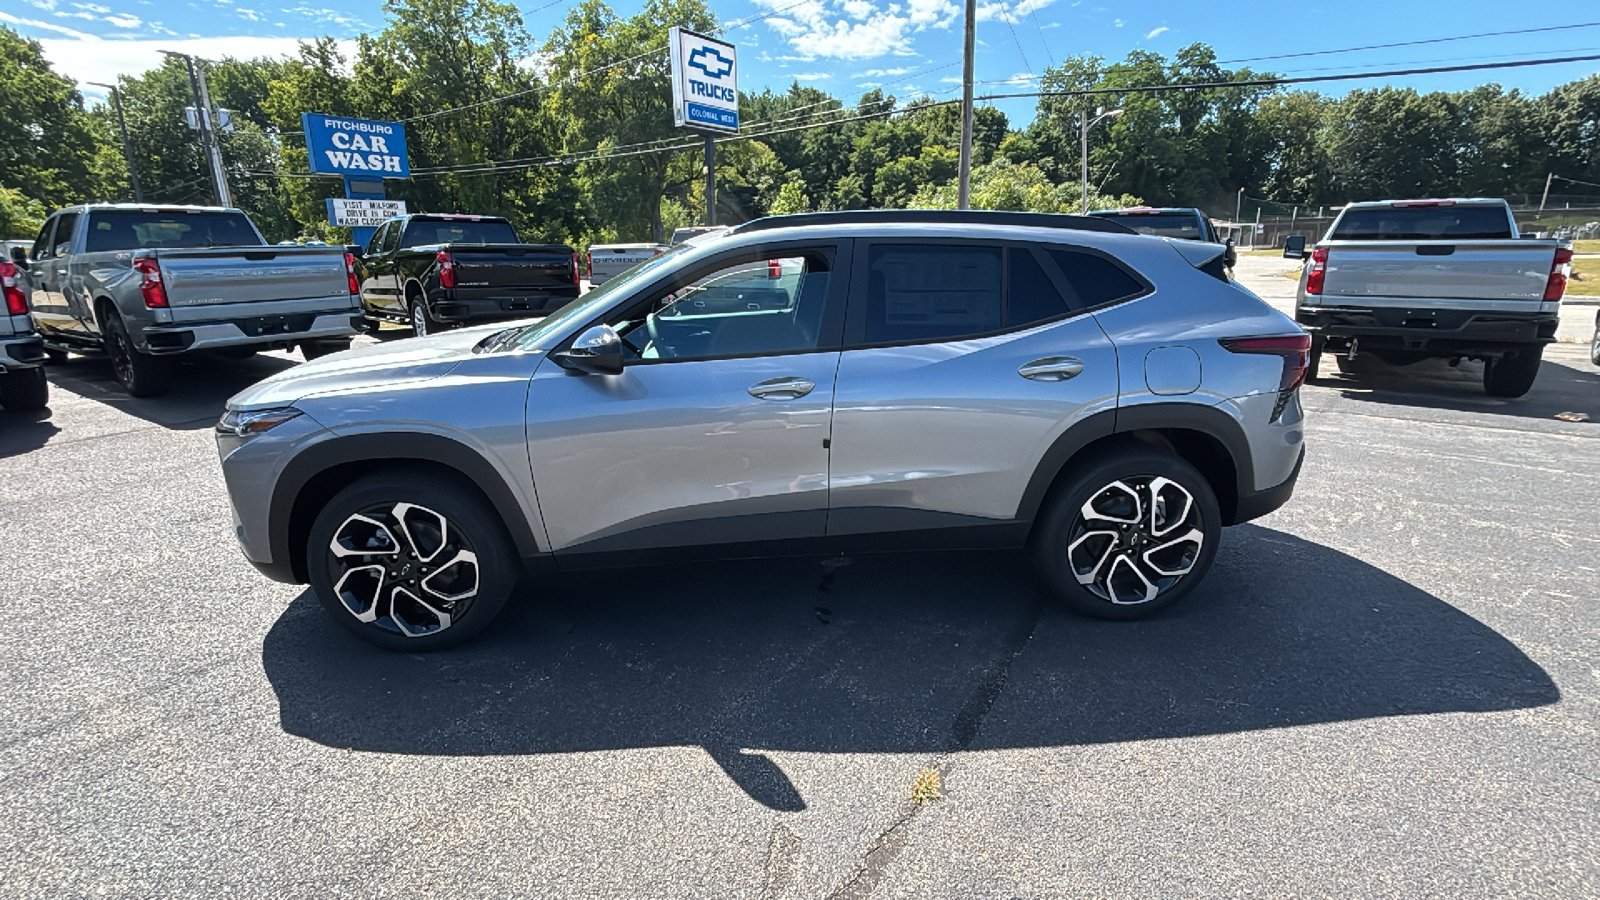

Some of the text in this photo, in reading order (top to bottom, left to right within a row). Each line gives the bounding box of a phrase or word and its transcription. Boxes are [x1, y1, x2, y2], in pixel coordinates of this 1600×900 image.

[689, 79, 734, 103] TRUCKS
[691, 108, 734, 124] COLONIAL WEST
[325, 119, 393, 135] FITCHBURG
[332, 132, 389, 153] CAR
[325, 150, 402, 172] WASH
[343, 201, 399, 210] VISIT MILFORD
[346, 209, 368, 218] DRIVE
[338, 217, 359, 226] WASH
